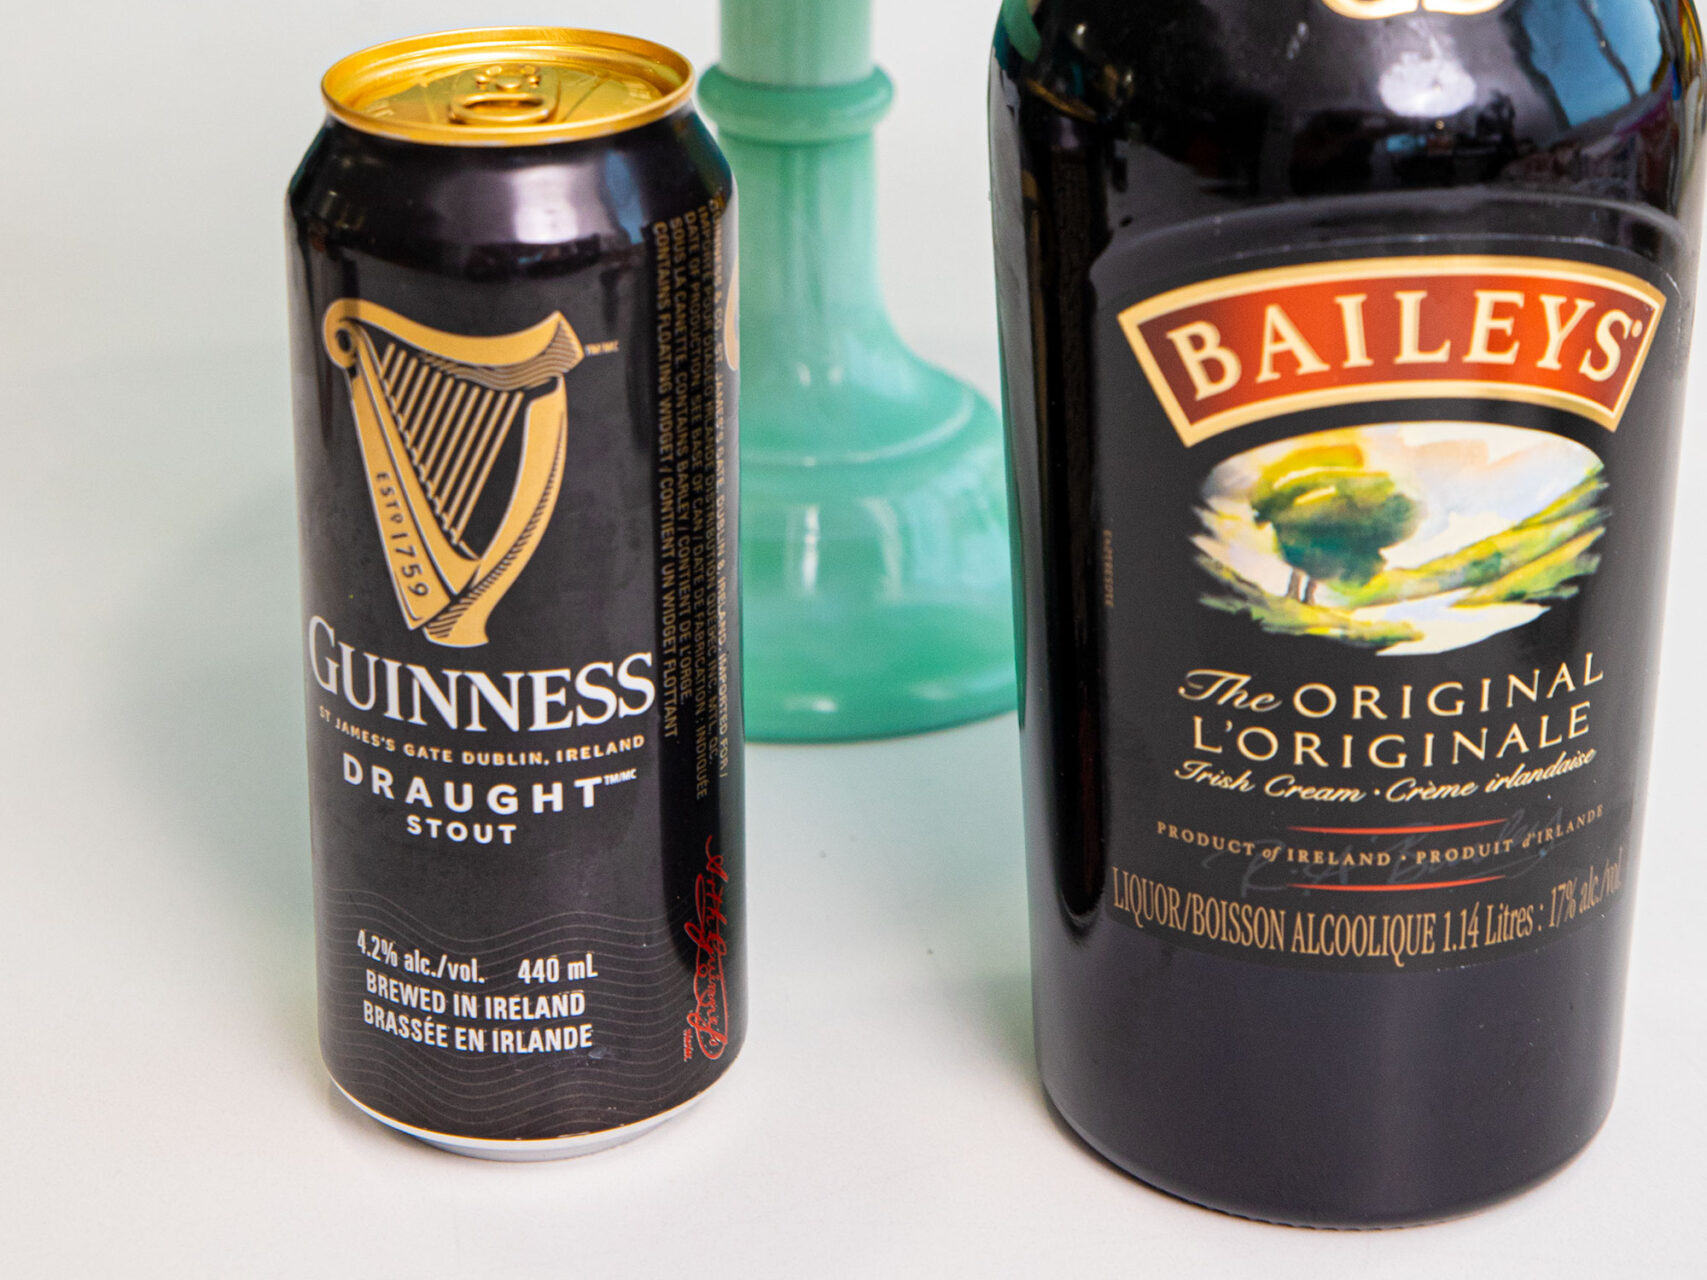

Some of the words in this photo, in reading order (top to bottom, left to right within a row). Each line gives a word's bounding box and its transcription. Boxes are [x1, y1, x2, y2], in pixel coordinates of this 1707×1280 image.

[669, 216, 686, 263] SOUS
[684, 211, 700, 253] DATE
[653, 221, 671, 311] CONTAINS
[674, 267, 687, 288] LA
[658, 313, 672, 394] FLOATING
[1166, 290, 1632, 401] BAILEYS
[659, 396, 674, 463] WIDGET
[676, 372, 689, 457] CONTAINS
[691, 394, 703, 423] SEE
[692, 428, 704, 471] BASE
[677, 460, 690, 521] BARLEY
[692, 474, 704, 493] OF
[693, 497, 704, 531] CAN
[660, 476, 675, 558] CONTIENT
[716, 494, 726, 557] DUBLIN
[391, 532, 429, 597] 1759
[662, 562, 676, 588] UN
[678, 535, 691, 616] CONTIENT
[693, 543, 705, 584] DATE
[662, 590, 677, 655] WIDGET
[694, 587, 705, 610] DE
[680, 619, 692, 643] DE
[309, 615, 656, 732] GUINNESS
[695, 612, 707, 715] FABRICATION
[718, 653, 728, 735] IMPORTED
[1178, 669, 1282, 712] The
[1293, 652, 1603, 719] ORIGINAL
[664, 658, 679, 738] FLOTTANT
[319, 705, 331, 722] ST
[335, 717, 396, 752] JAMES'S
[403, 742, 453, 763] GATE
[556, 734, 645, 763] IRELAND
[696, 725, 710, 799] INDIQUÉE
[719, 737, 728, 769] FOR
[1193, 701, 1591, 768] L'ORIGINALE
[343, 752, 602, 815] DRAUGHT
[1174, 760, 1255, 792] Irish
[1264, 774, 1366, 802] Cream
[1386, 777, 1478, 802] Crème
[1485, 748, 1597, 793] irlandaise
[406, 814, 517, 845] STOUT
[1157, 821, 1255, 856] PRODUCT
[1262, 846, 1282, 862] of
[1287, 848, 1391, 867] IRELAND
[1416, 839, 1513, 864] PRODUIT
[1112, 866, 1286, 952] LIQUOR/BOISSON
[1291, 911, 1436, 968] ALCOOLIQUE
[1442, 901, 1480, 953] 1.14
[1484, 902, 1535, 946] Litres
[1549, 877, 1578, 929] 17%
[357, 928, 398, 968] 4.2%
[404, 948, 486, 984] alc./vol.
[518, 958, 560, 985] 440
[567, 952, 598, 981] mL
[366, 969, 446, 1015] BREWED
[453, 993, 478, 1019] IN
[485, 992, 586, 1021] IRELAND
[363, 1000, 449, 1048] BRASSÉE
[455, 1027, 485, 1052] EN
[492, 1024, 594, 1054] IRLANDE
